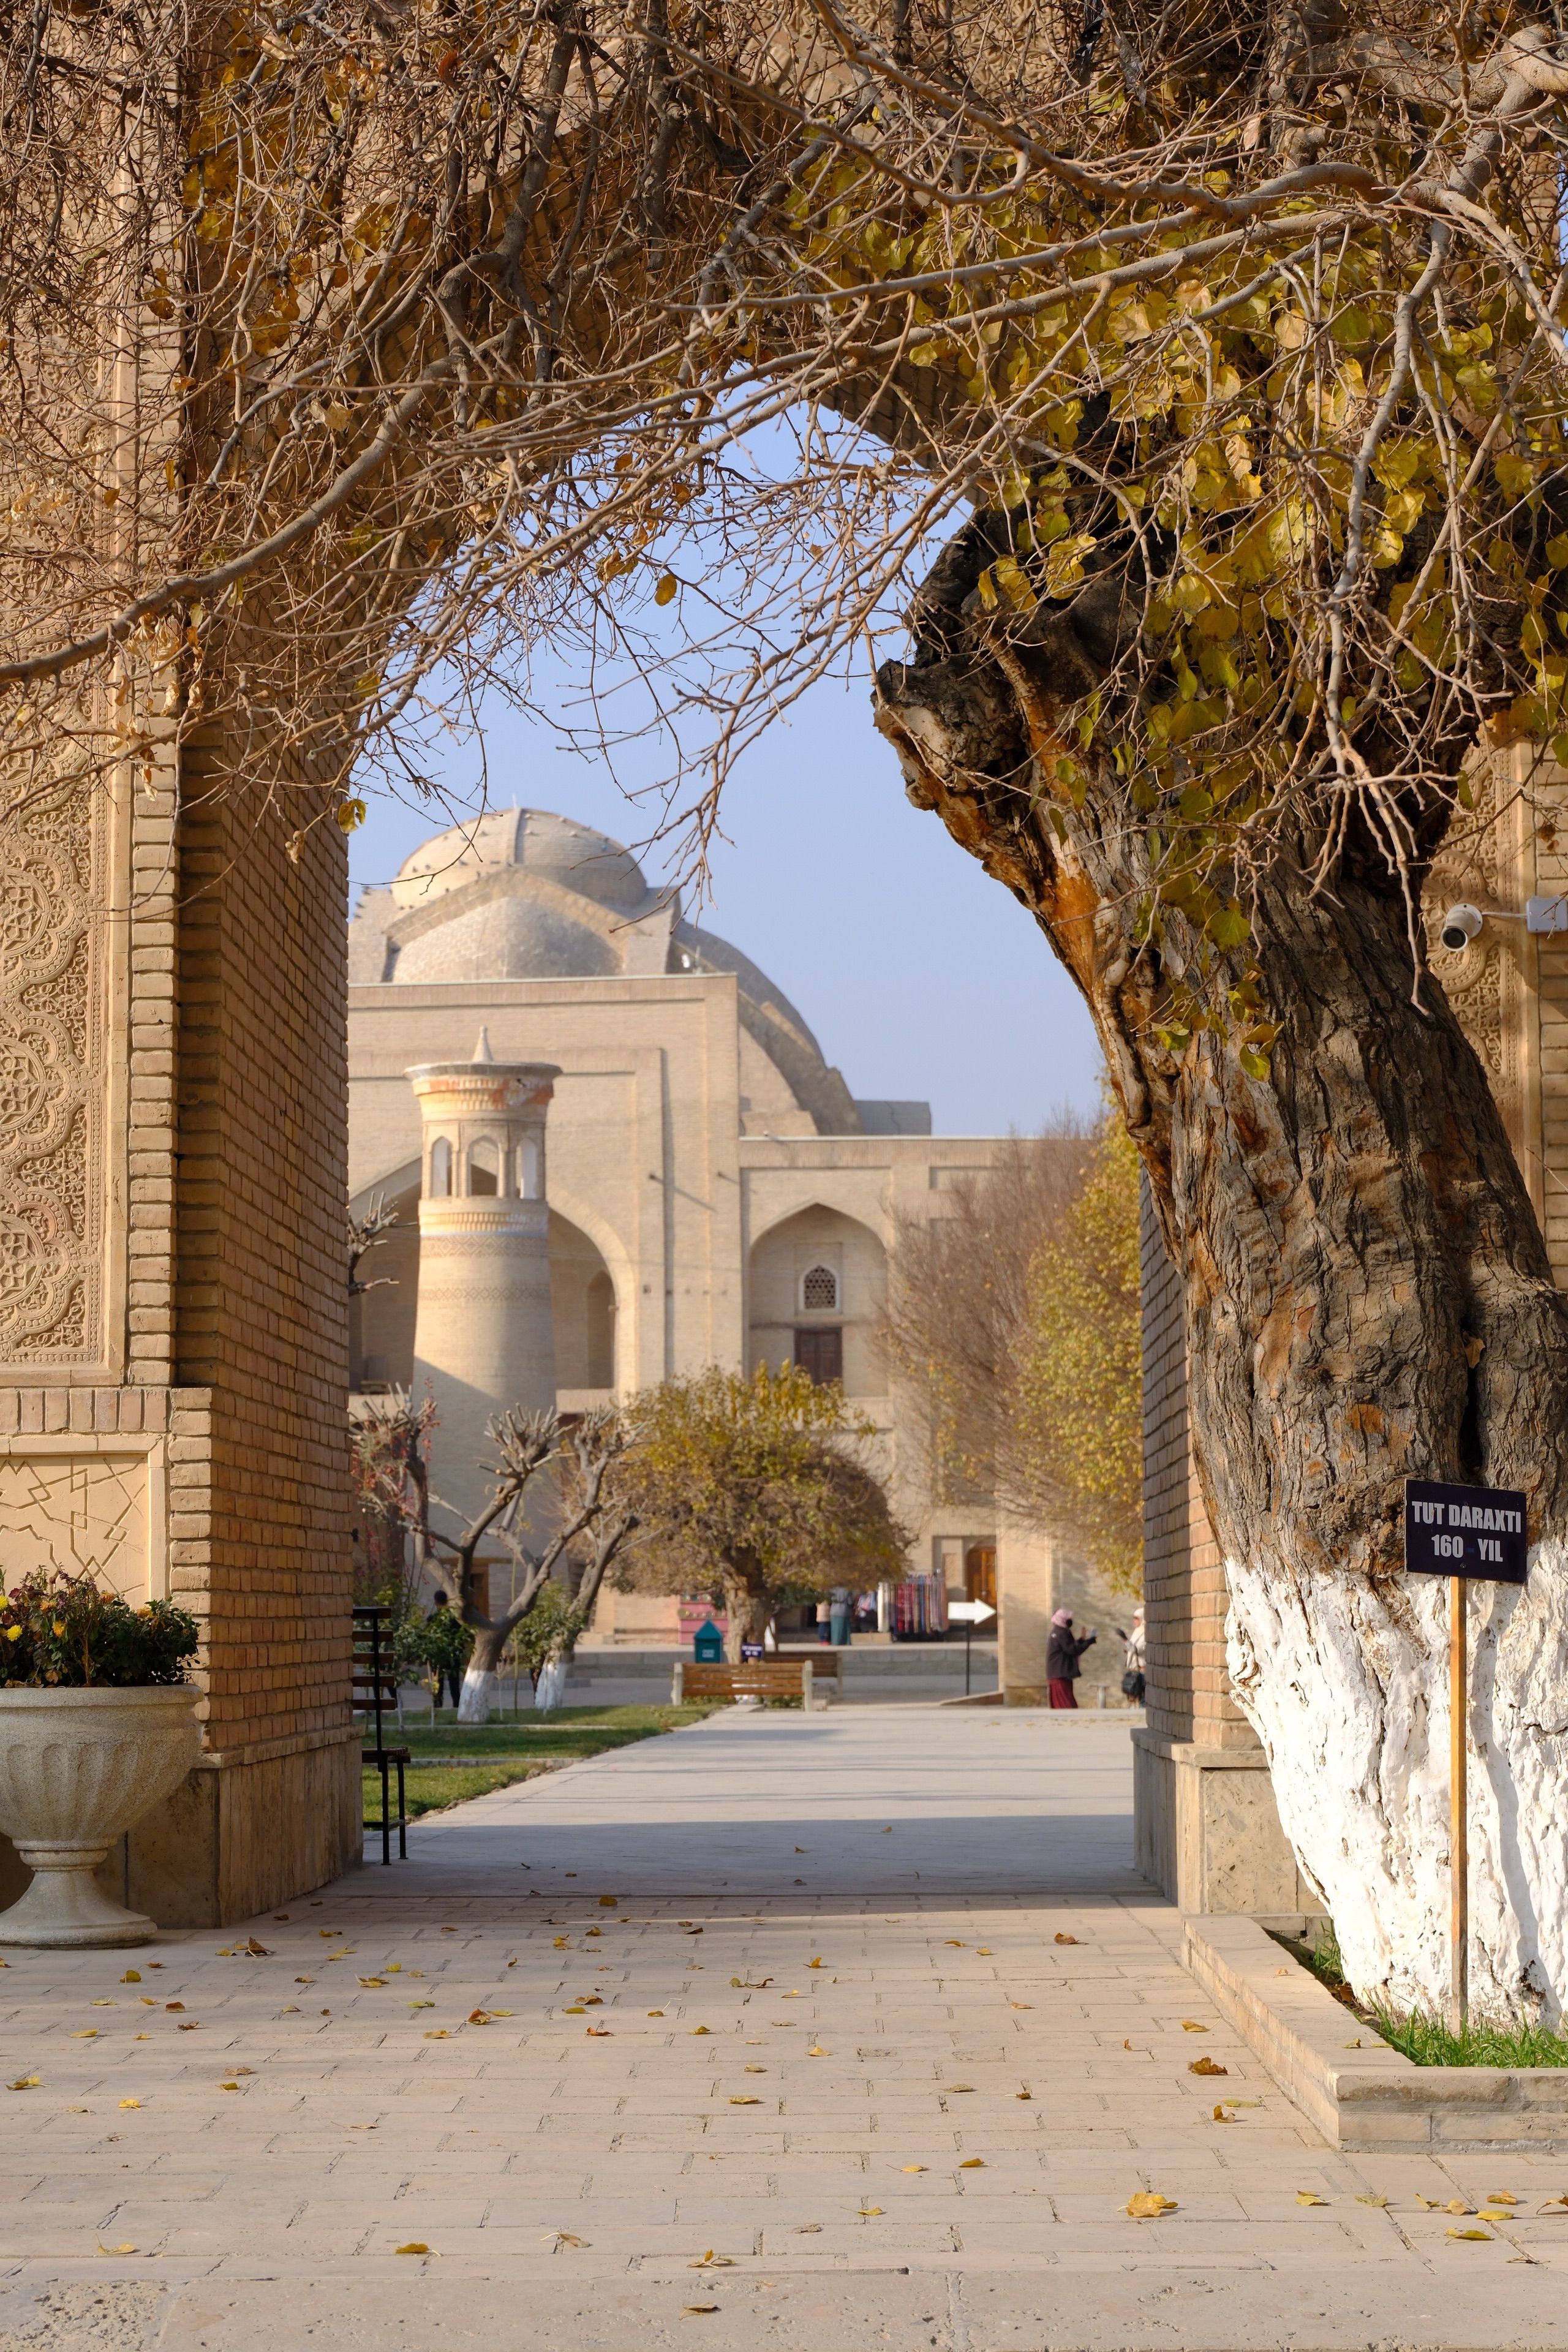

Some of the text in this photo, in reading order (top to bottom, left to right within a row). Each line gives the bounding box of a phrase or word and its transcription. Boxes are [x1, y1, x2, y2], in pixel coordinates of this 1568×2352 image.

[1412, 1501, 1521, 1533] TUT DARAXTI
[1431, 1534, 1503, 1562] 160 YIL
